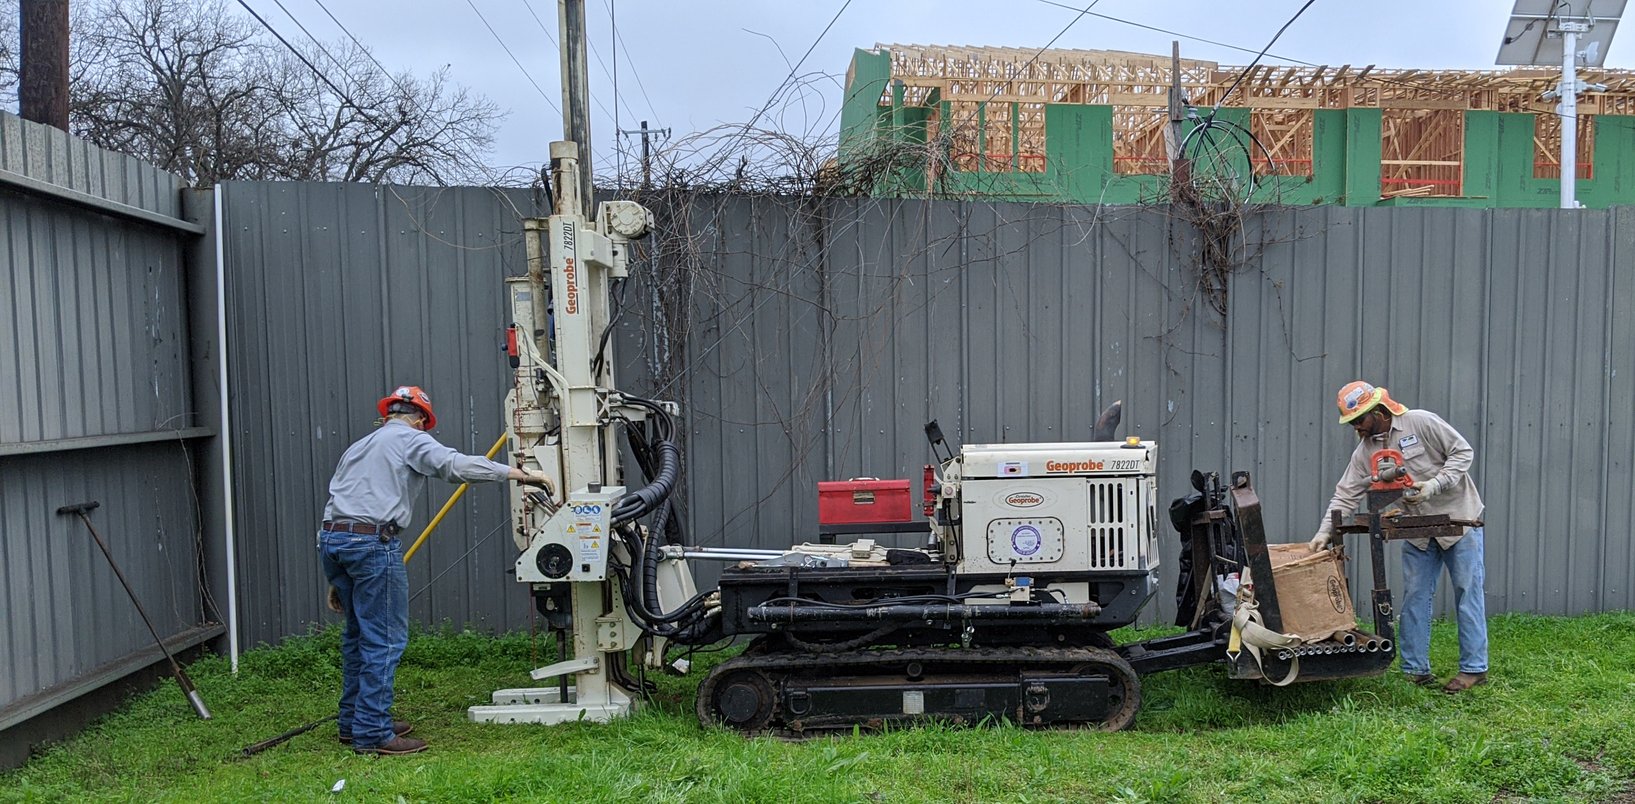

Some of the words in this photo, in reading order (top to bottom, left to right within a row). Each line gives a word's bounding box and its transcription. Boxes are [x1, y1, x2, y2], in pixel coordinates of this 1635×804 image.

[563, 222, 574, 250] 7822DT
[564, 258, 577, 315] Geoprobe
[1046, 459, 1104, 473] Geoprobe
[1111, 460, 1140, 470] 7822DT
[1008, 497, 1040, 505] Geoprobe
